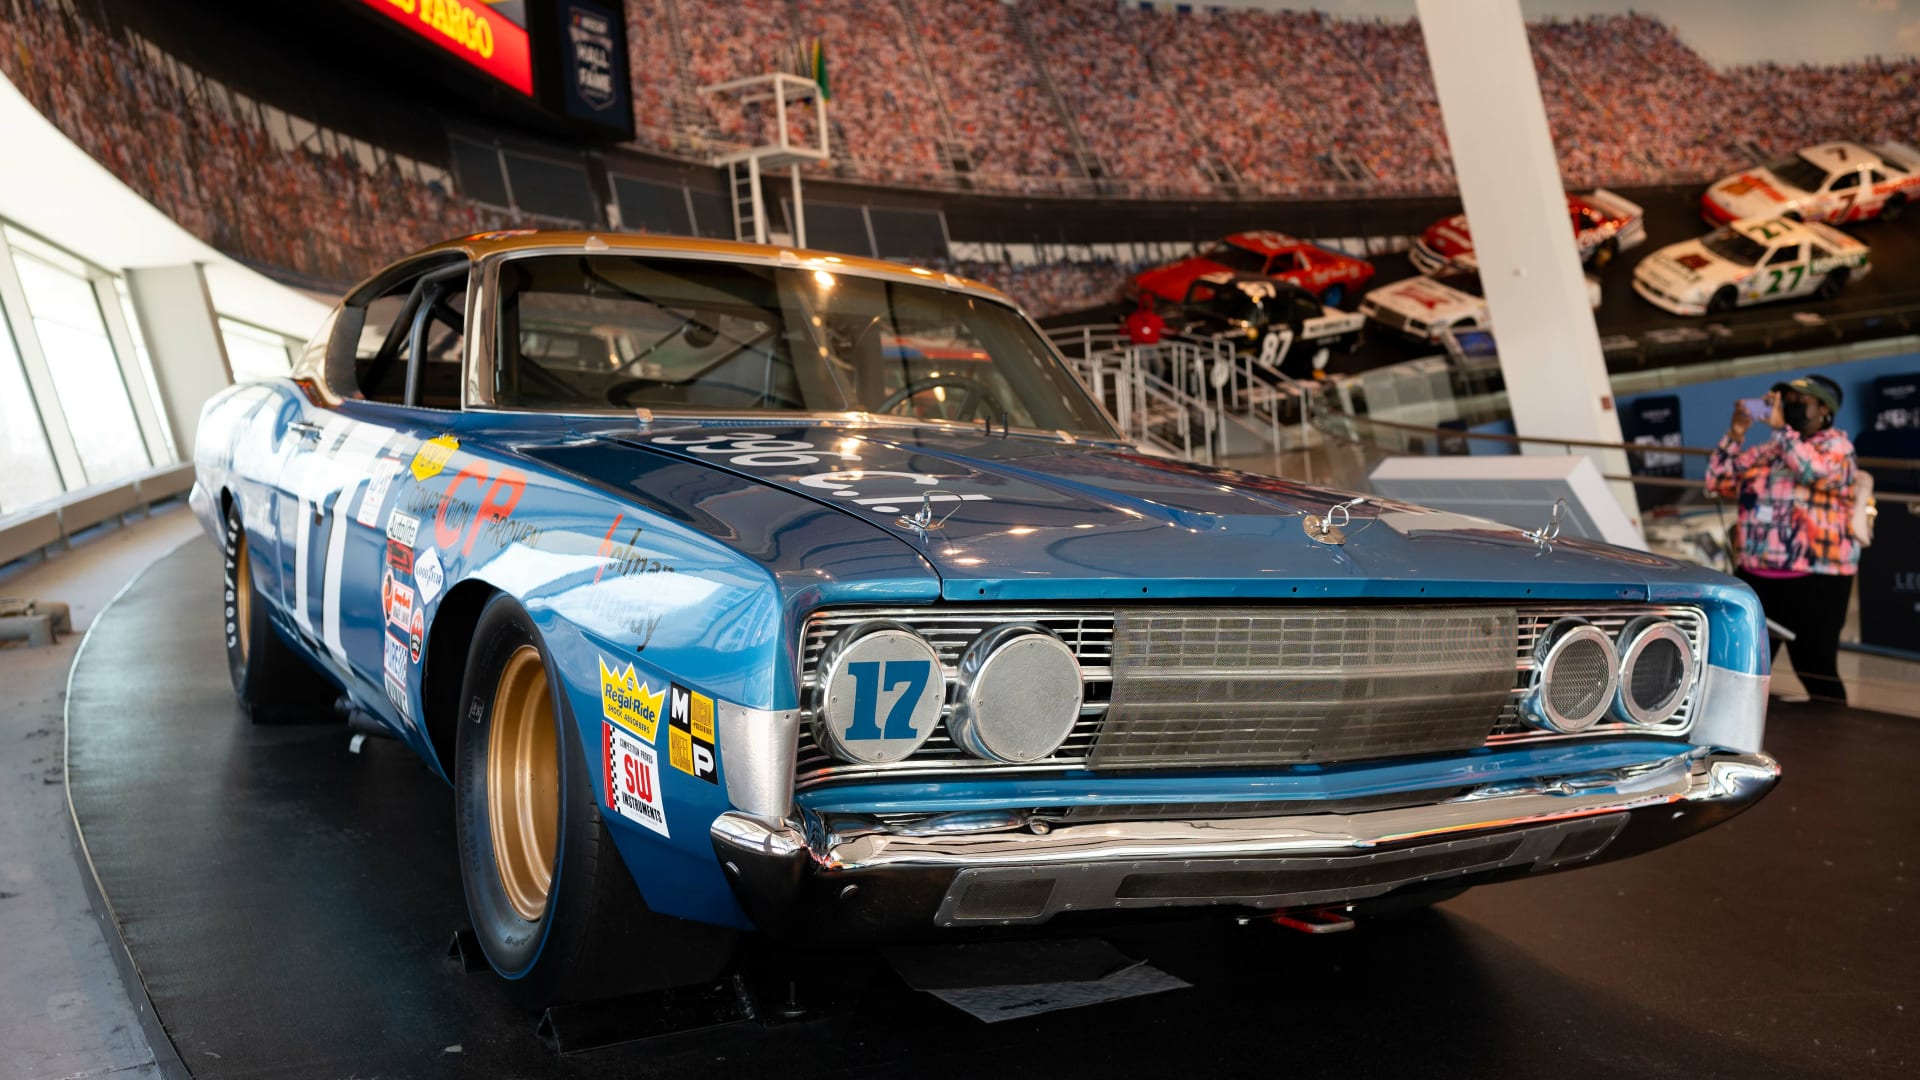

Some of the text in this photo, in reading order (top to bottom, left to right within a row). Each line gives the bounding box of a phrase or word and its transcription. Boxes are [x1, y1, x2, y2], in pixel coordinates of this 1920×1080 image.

[419, 0, 494, 59] FARGO
[1764, 265, 1806, 296] 27
[1260, 329, 1294, 368] 87
[434, 459, 528, 556] CP
[389, 513, 416, 545] Autolite
[608, 704, 650, 734] SHOCK ABSORBERS
[671, 687, 689, 725] M
[845, 661, 931, 741] 17
[620, 738, 640, 756] COMPETITION
[693, 743, 715, 777] P
[624, 753, 653, 804] SW
[621, 791, 663, 824] INSTRUMENTS
